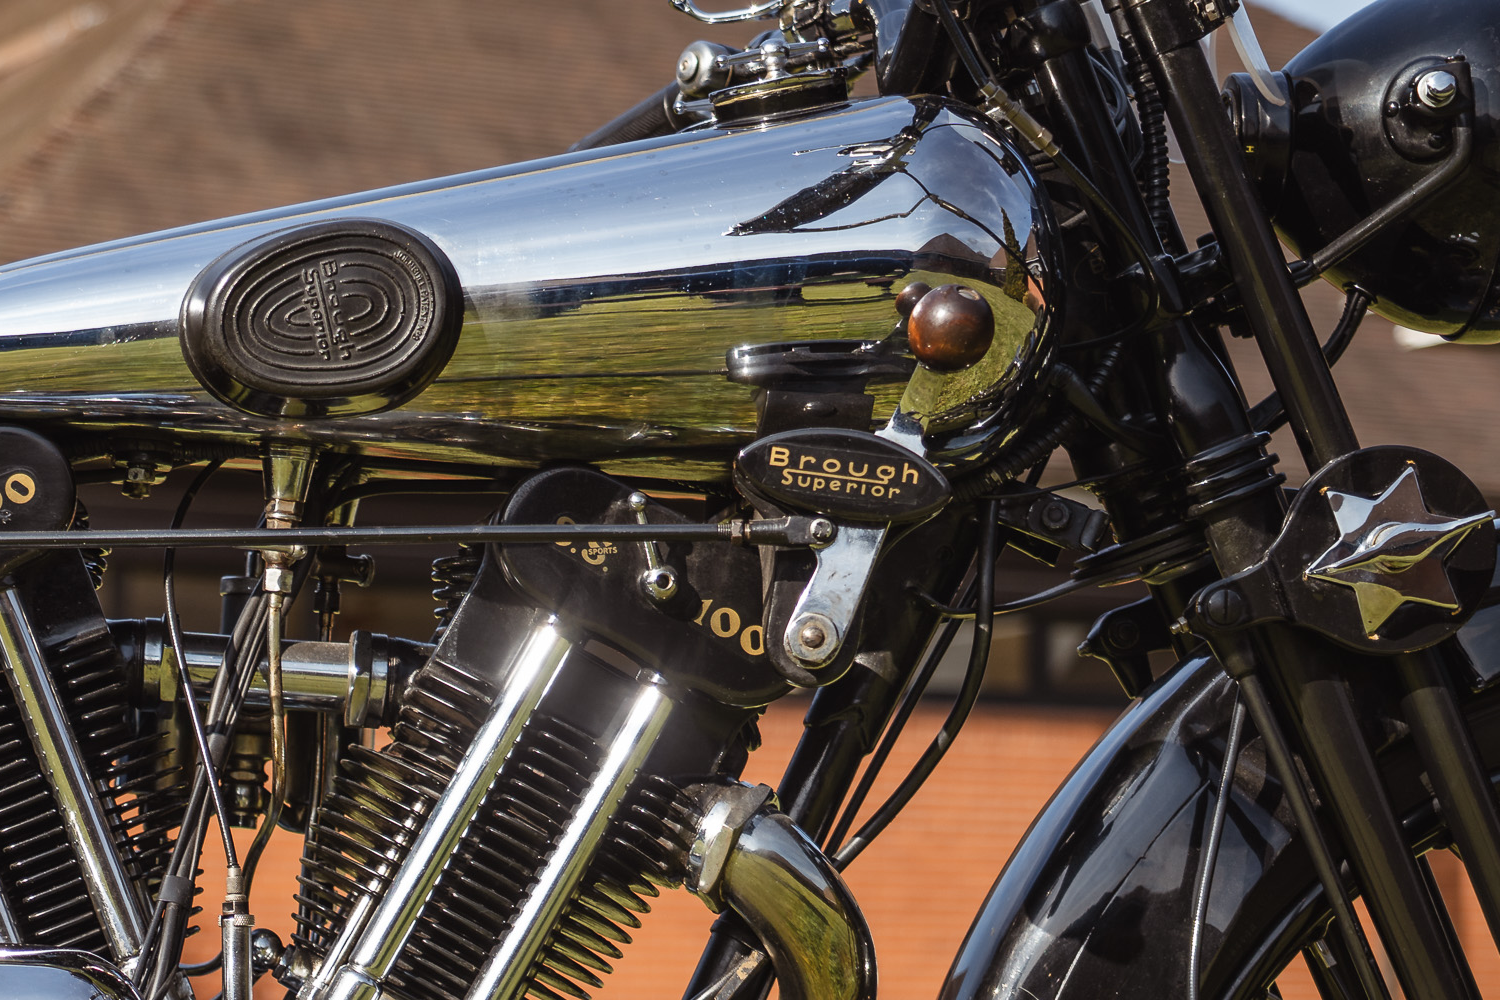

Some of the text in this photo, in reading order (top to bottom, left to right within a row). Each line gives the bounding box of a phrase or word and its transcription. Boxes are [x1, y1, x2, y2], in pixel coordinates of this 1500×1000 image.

[301, 268, 331, 362] Superior
[319, 258, 356, 360] Brough
[768, 446, 920, 485] Brough
[781, 468, 901, 499] Superior
[588, 546, 618, 556] SPORTS
[693, 599, 765, 656] 100
